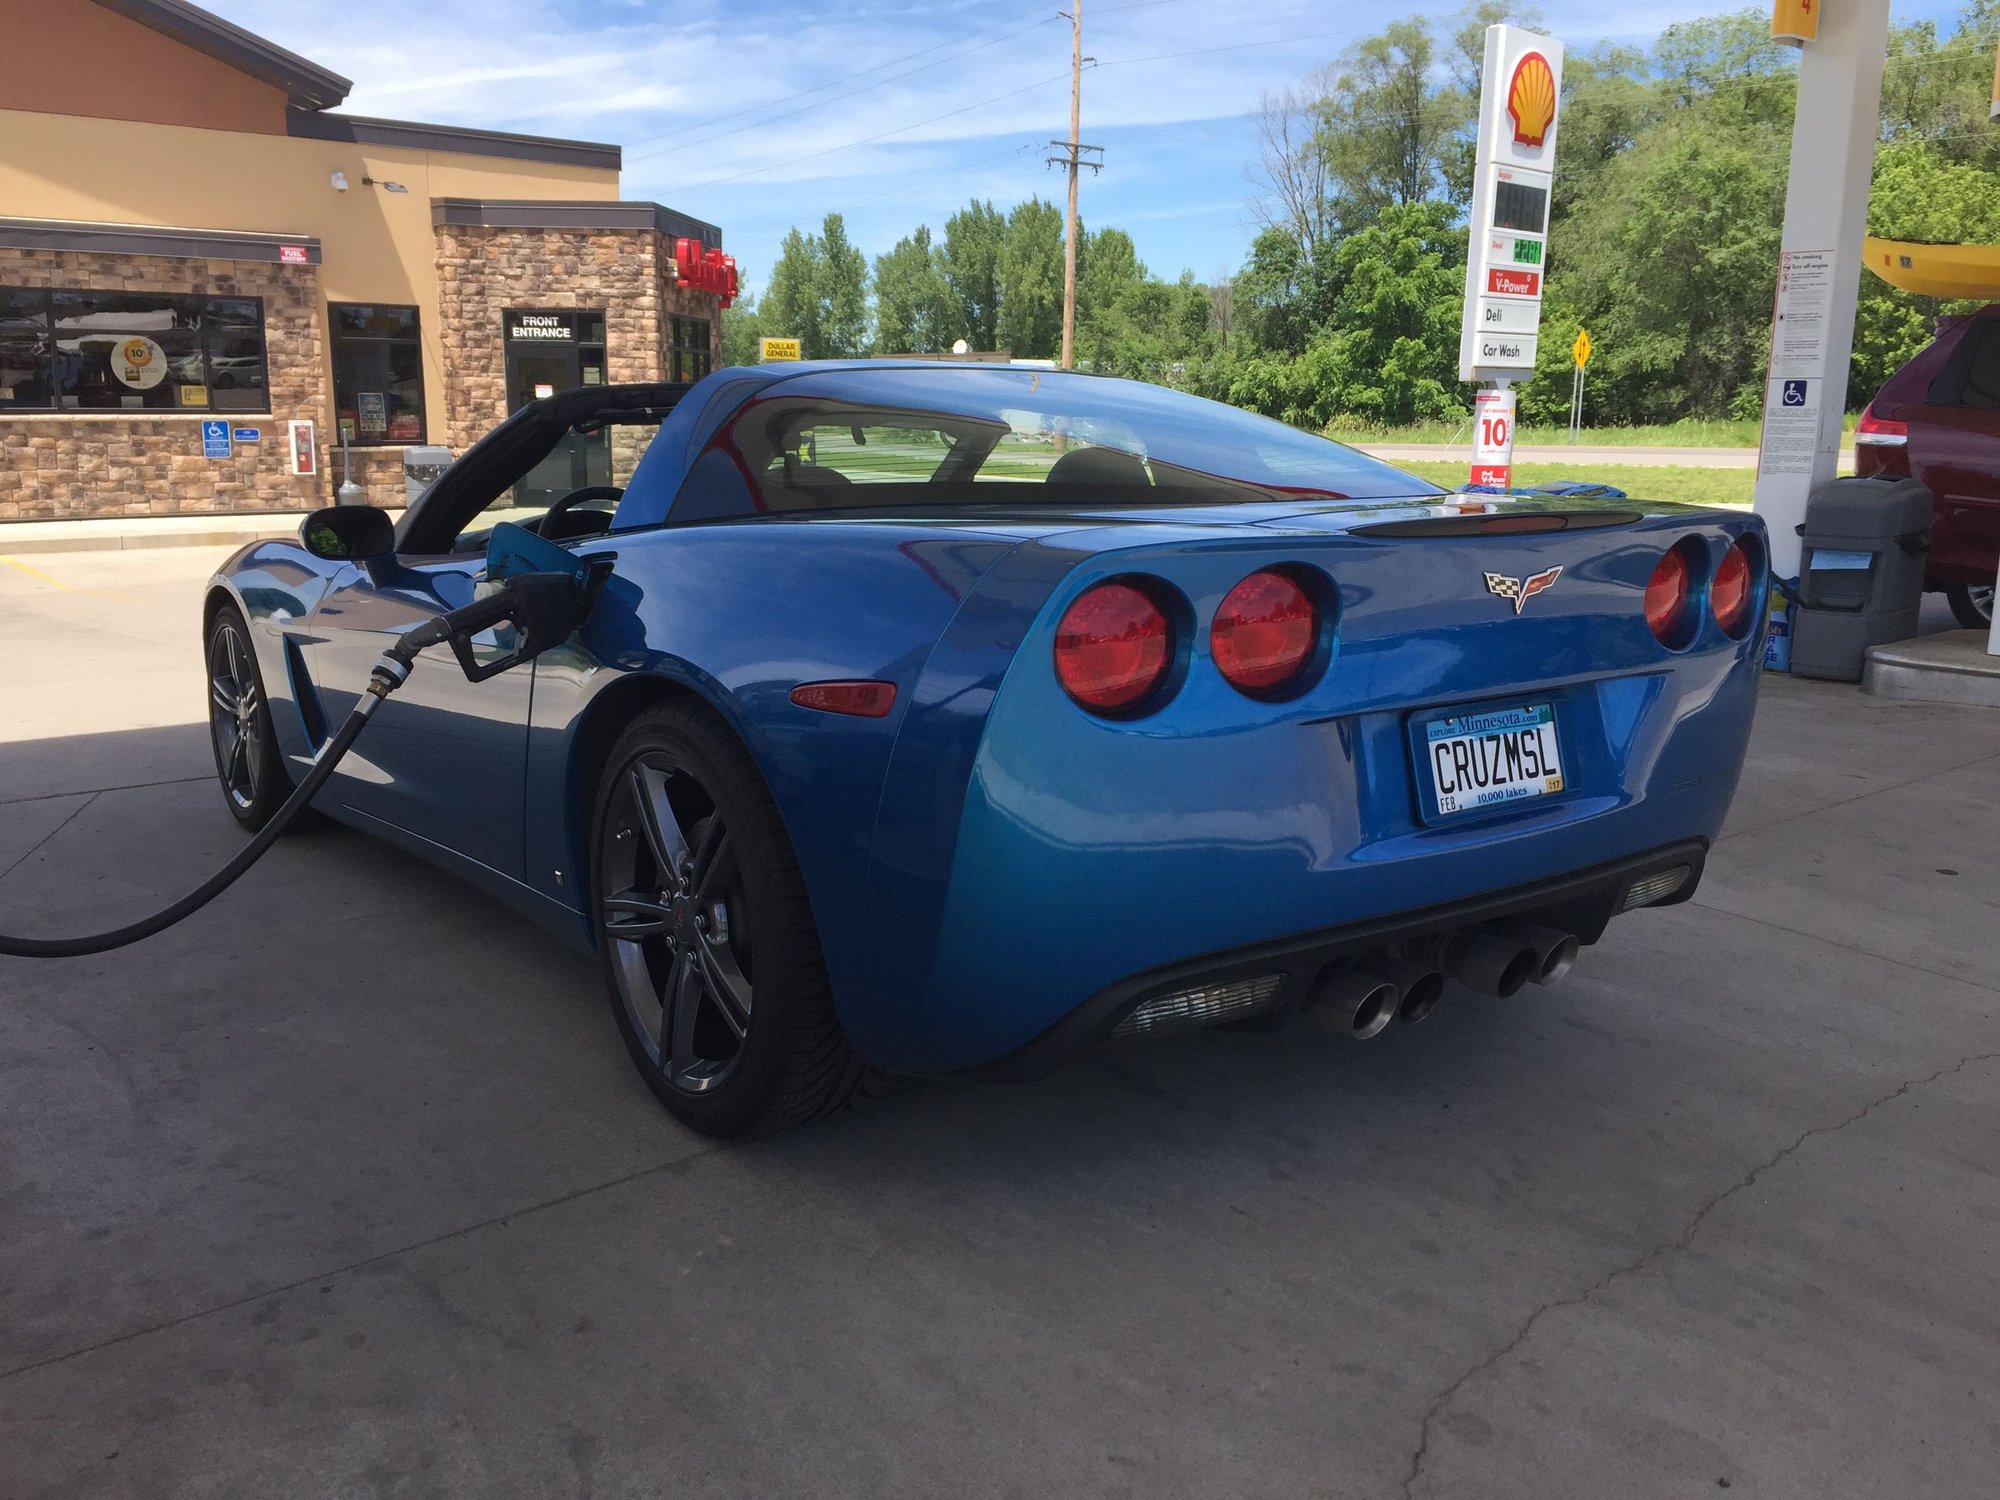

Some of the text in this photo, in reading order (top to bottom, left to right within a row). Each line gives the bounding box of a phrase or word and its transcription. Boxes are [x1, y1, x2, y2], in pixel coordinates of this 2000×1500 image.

[1496, 278, 1530, 294] V-Power
[522, 316, 559, 326] FRONT
[1486, 308, 1502, 322] Deli
[512, 327, 571, 337] ENTRANCE
[767, 342, 796, 350] DOLLAR
[1483, 343, 1520, 358] Car Wash
[766, 350, 797, 358] GENERAL
[1429, 728, 1456, 738] EXPLORE
[1434, 728, 1556, 794] CRUZMSL
[1477, 787, 1528, 804] 10,000 lakes
[1440, 796, 1456, 812] FEB
